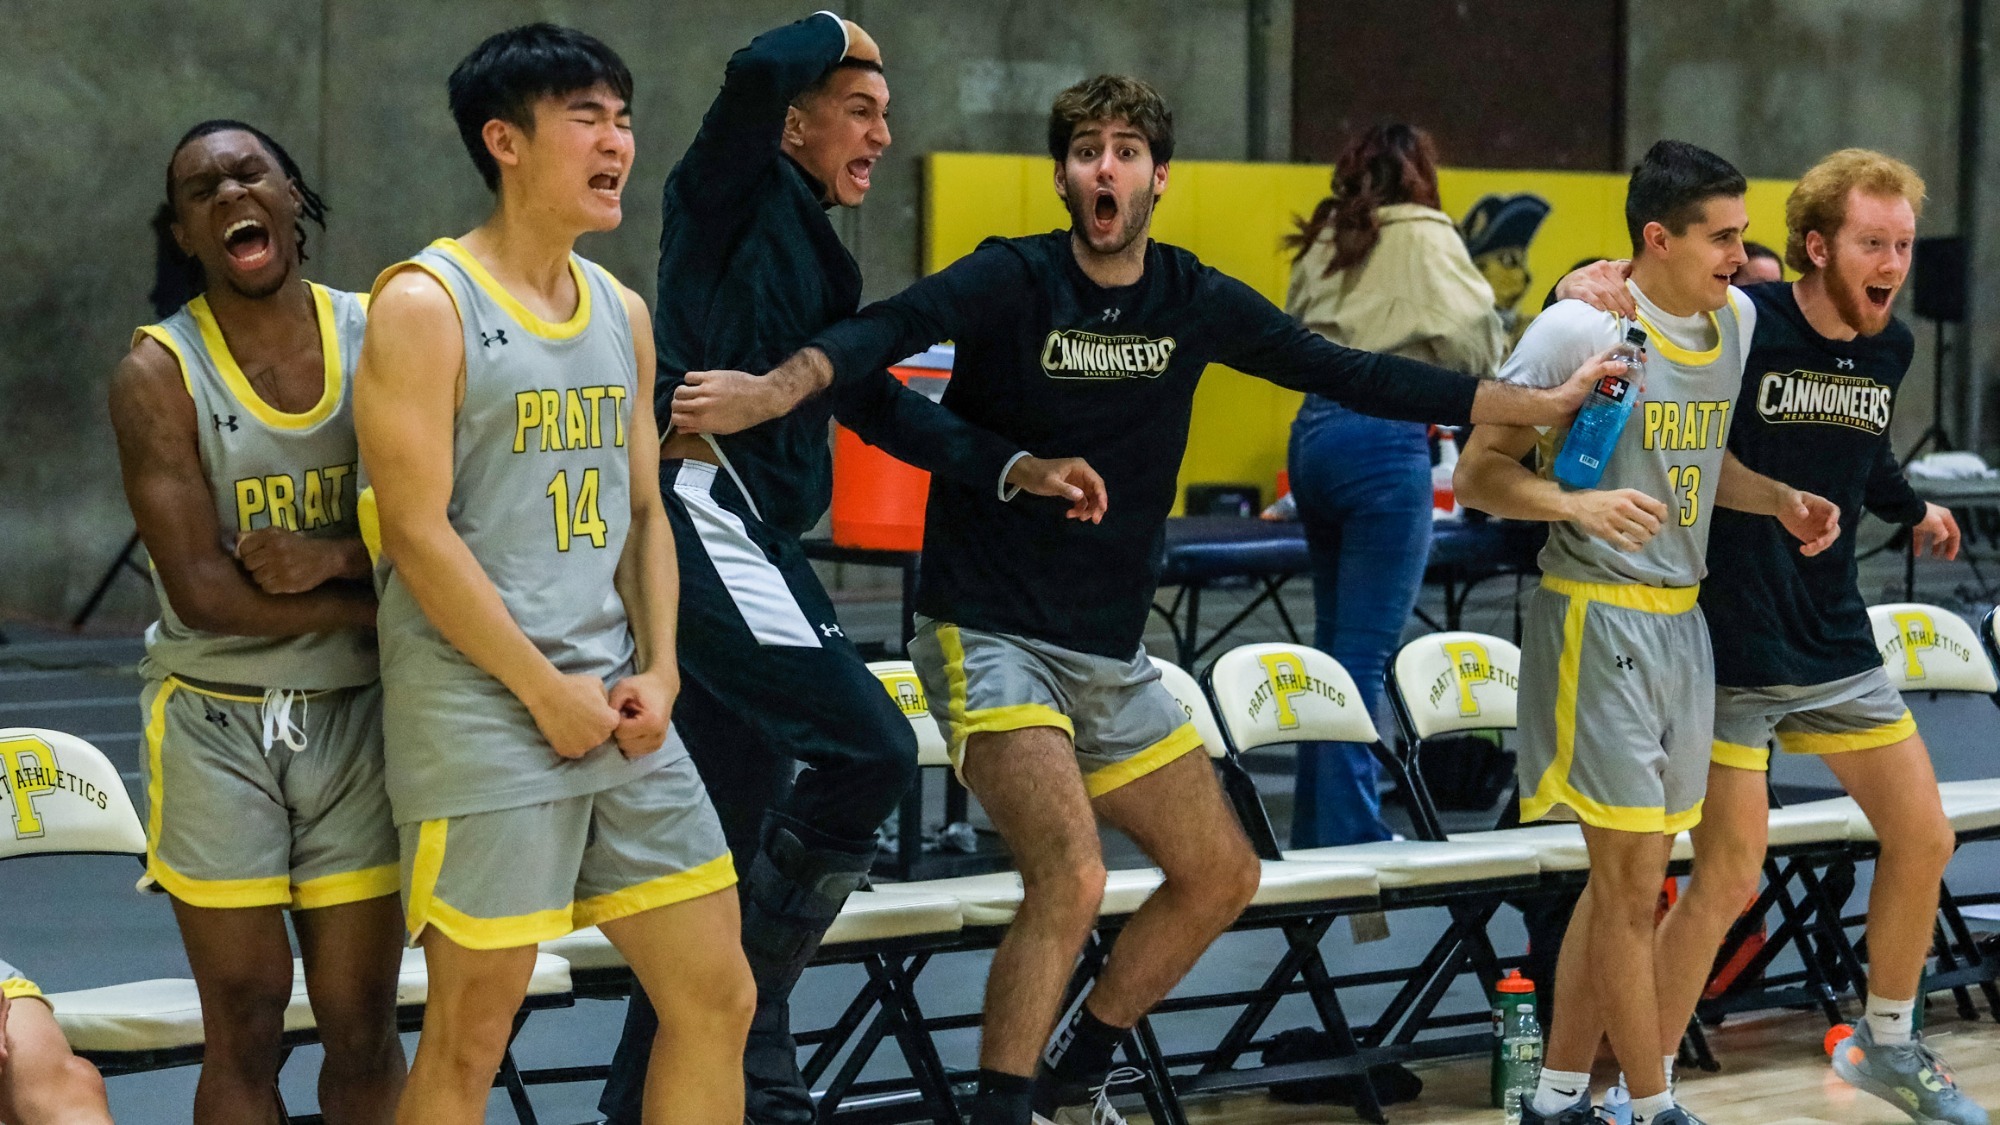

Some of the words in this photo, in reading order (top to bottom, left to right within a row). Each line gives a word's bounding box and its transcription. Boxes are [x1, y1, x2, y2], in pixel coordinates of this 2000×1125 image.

[1042, 332, 1175, 372] CANNONEERS
[1075, 333, 1097, 342] PRATT
[1759, 374, 1892, 429] CANNONEERS
[1802, 372, 1829, 383] PRATT
[1832, 375, 1870, 386] INSTITUTE
[512, 385, 627, 453] PRATT
[1643, 399, 1730, 451] PRATT
[1782, 413, 1815, 421] MEN'S
[1819, 413, 1875, 430] BASKETBALL
[234, 462, 358, 533] PRAT
[546, 468, 608, 552] 14
[1888, 610, 1936, 681] P
[1906, 631, 1970, 663] ATHLETICS
[1248, 679, 1273, 723] PRATT
[1275, 674, 1346, 708] ATHLETICS
[1256, 651, 1308, 731] P
[1429, 667, 1455, 710] PRATT
[1459, 663, 1518, 691] ATHLETIC
[1440, 641, 1491, 718] P
[0, 734, 60, 840] P
[15, 767, 108, 810] ATHLETICS
